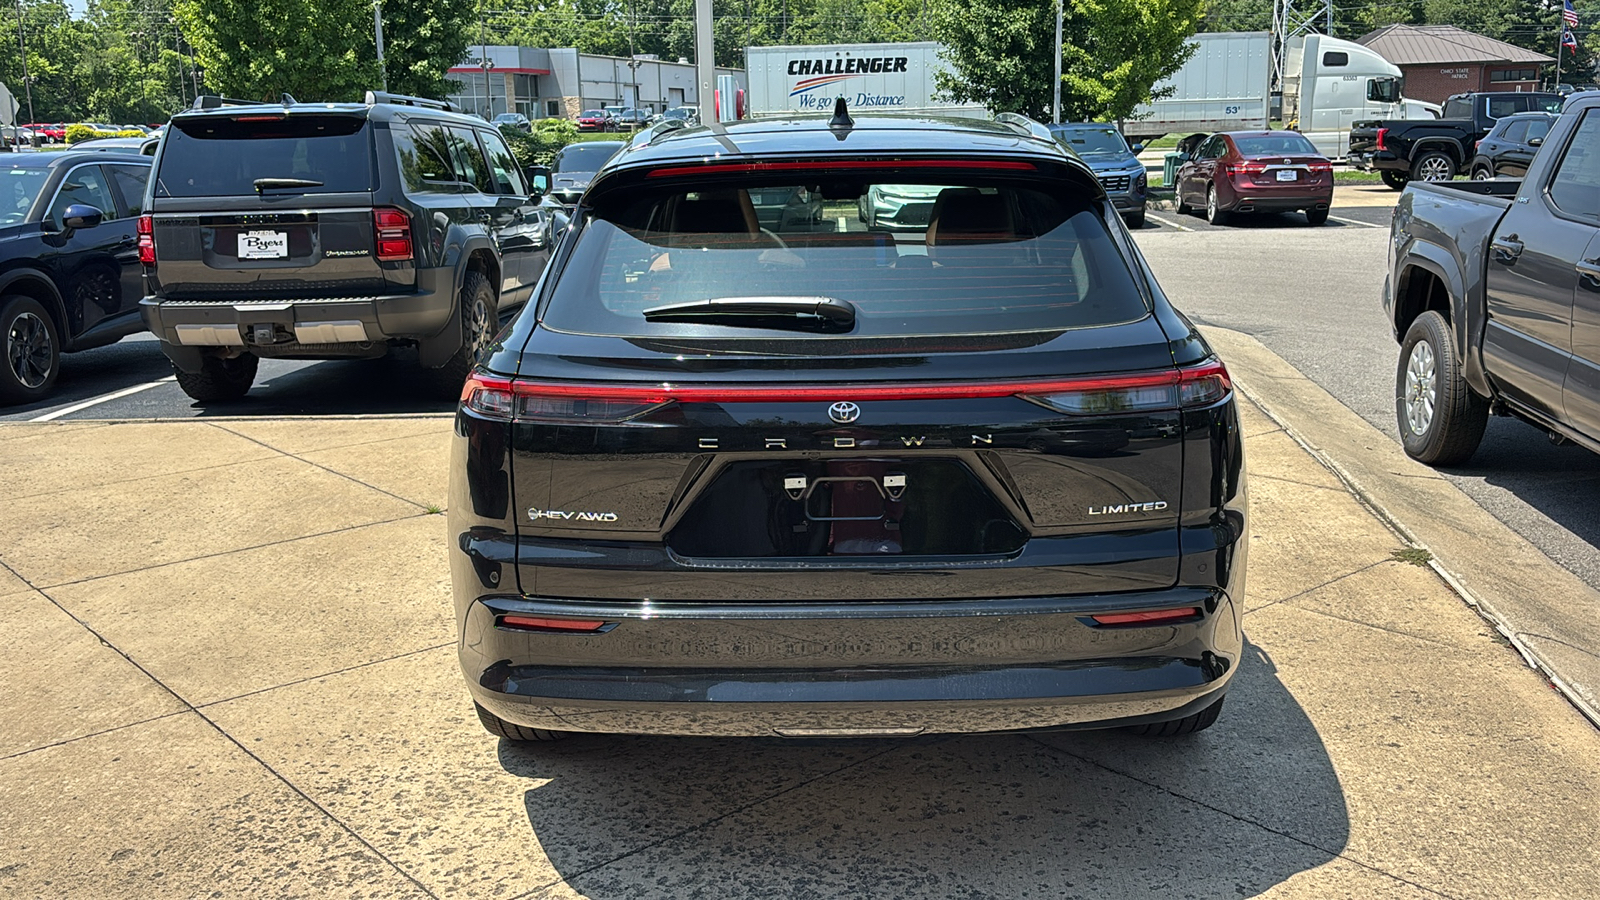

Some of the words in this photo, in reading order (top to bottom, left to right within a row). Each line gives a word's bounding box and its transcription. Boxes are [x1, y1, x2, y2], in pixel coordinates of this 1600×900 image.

[787, 57, 908, 75] CHALLENGER
[799, 94, 815, 107] We
[816, 98, 832, 110] go
[855, 93, 905, 107] Distance
[1225, 106, 1241, 114] 53'
[242, 236, 283, 251] Byers
[698, 434, 993, 449] CROWN
[538, 509, 575, 520] HEV
[575, 511, 619, 522] AWD
[1088, 501, 1168, 515] LIMITED
